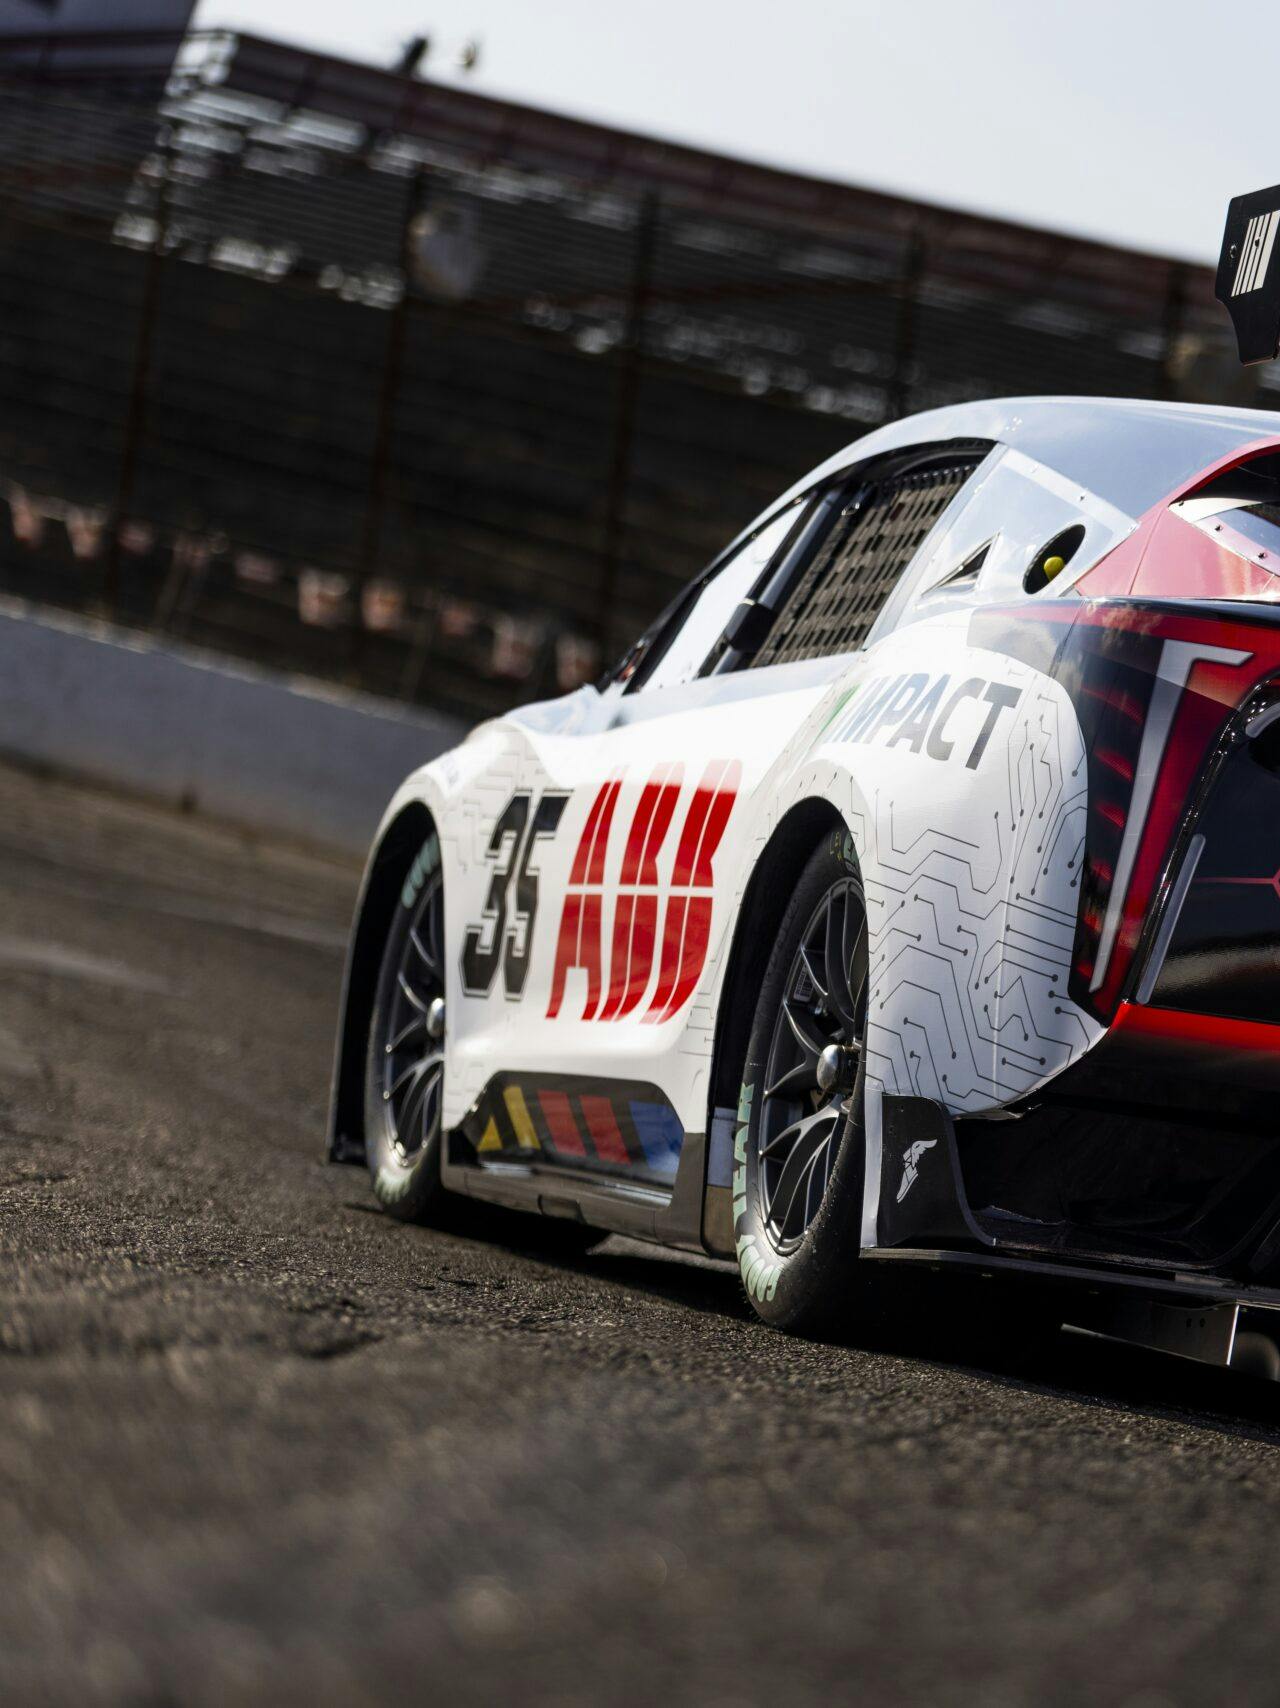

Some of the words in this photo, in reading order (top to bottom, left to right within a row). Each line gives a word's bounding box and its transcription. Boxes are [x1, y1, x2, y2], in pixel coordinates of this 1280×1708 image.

[820, 672, 1023, 771] IMPACT
[458, 787, 574, 1002] 35
[545, 757, 742, 1026] ABB
